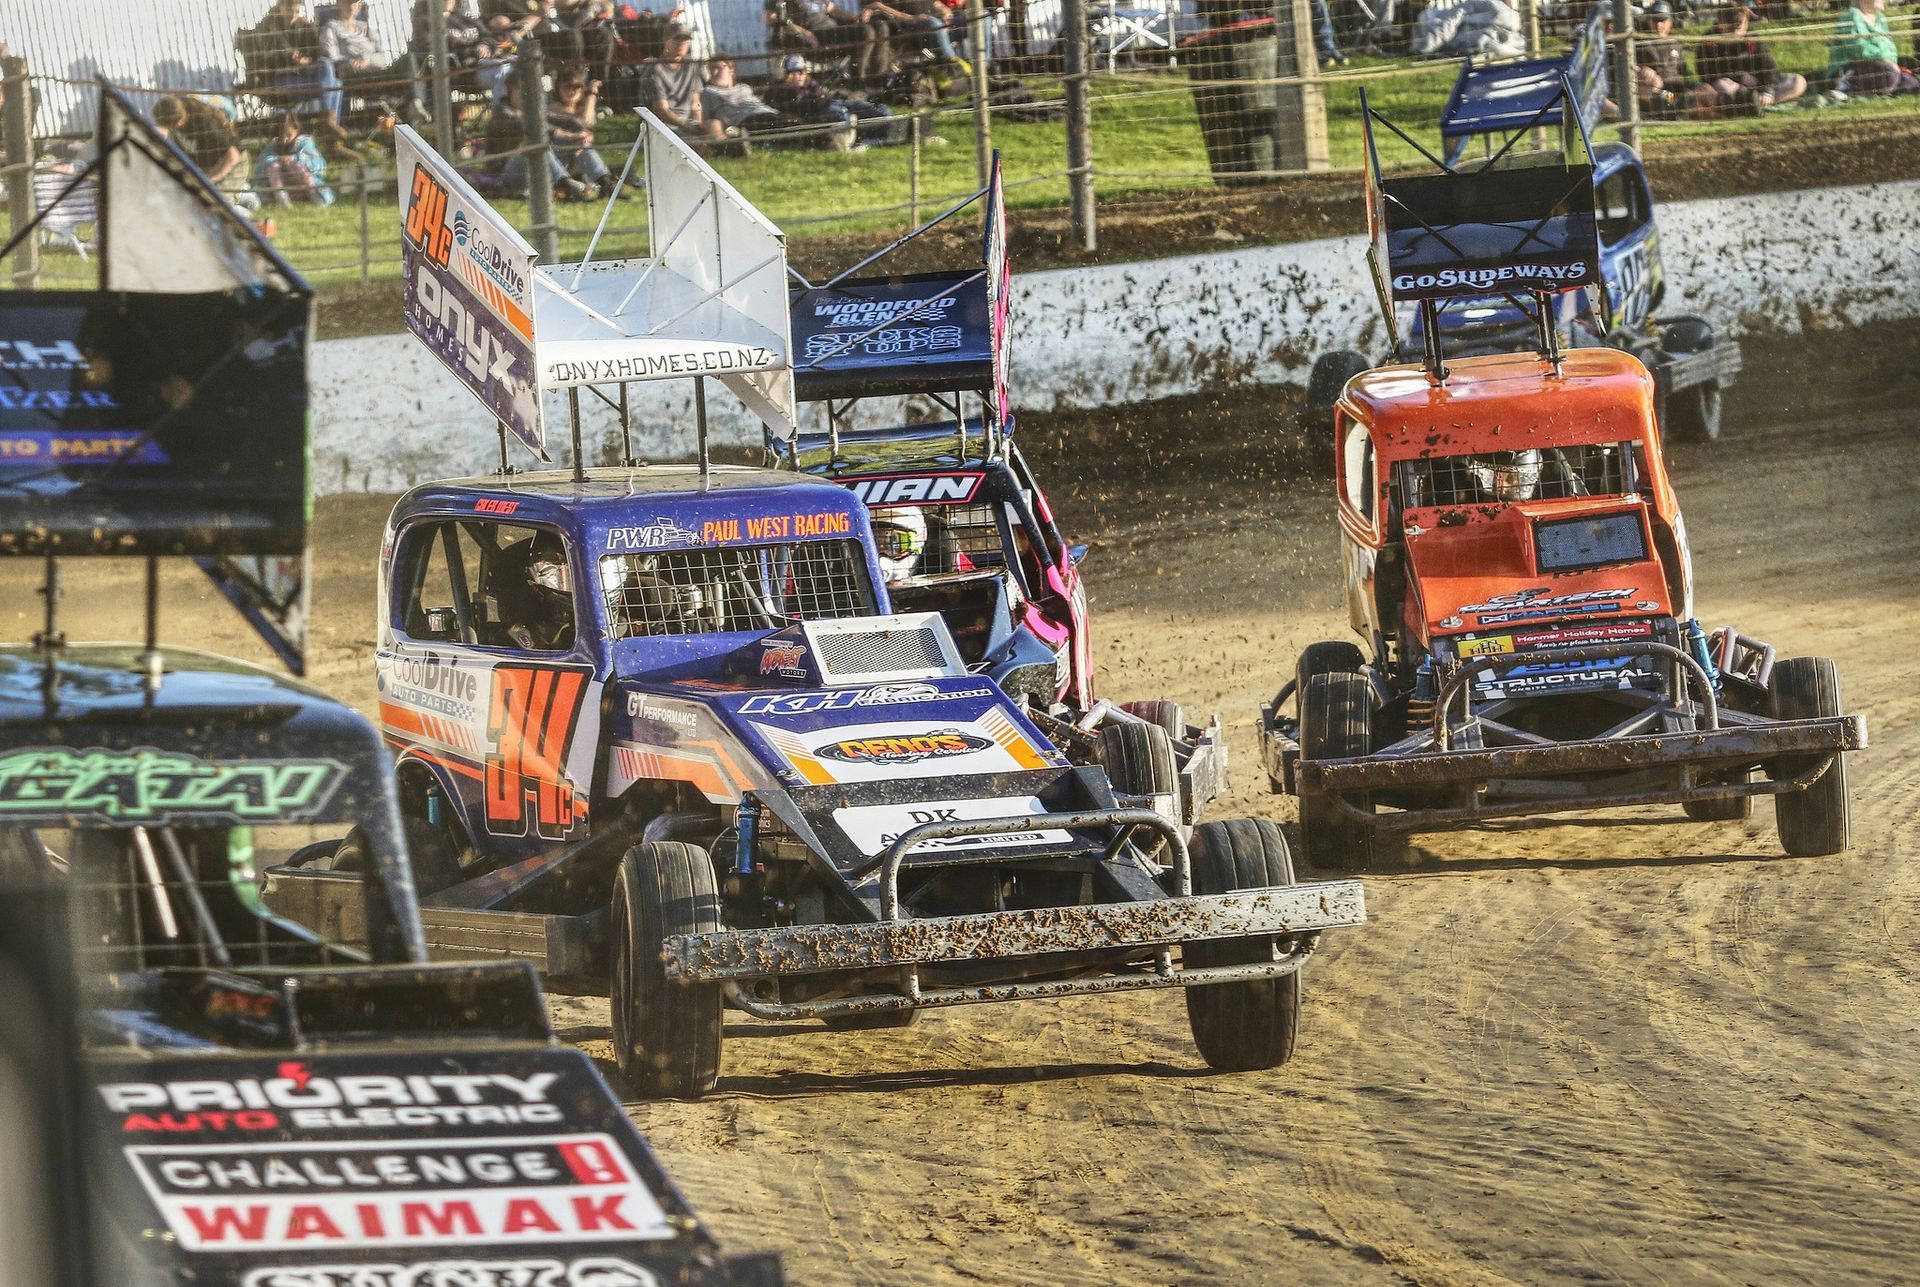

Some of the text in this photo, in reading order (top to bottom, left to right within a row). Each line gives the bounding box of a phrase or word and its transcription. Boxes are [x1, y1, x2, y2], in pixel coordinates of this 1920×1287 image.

[471, 228, 523, 293] CoolDrive
[832, 310, 896, 324] GLEN
[415, 304, 464, 362] HOMES
[555, 347, 765, 382] ONYXHOMES.CO.NZ
[607, 512, 850, 549] PWR PAUL WEST RACING
[1564, 628, 1604, 639] Holiday
[1608, 627, 1645, 635] Homes
[393, 645, 477, 702] CoolDrive
[1475, 668, 1651, 691] STRUCTURAL
[393, 685, 454, 712] AUTO PARTS
[627, 692, 697, 726] GT PERFORMANCE
[738, 689, 994, 714] KH FABRICATION
[880, 750, 932, 760] Towing
[907, 809, 962, 824] DK
[980, 831, 1038, 843] LIMITED
[99, 1073, 559, 1112] PRIORITY
[123, 1103, 565, 1133] AUTO ELECTRIC
[182, 1196, 637, 1242] WAIMAK
